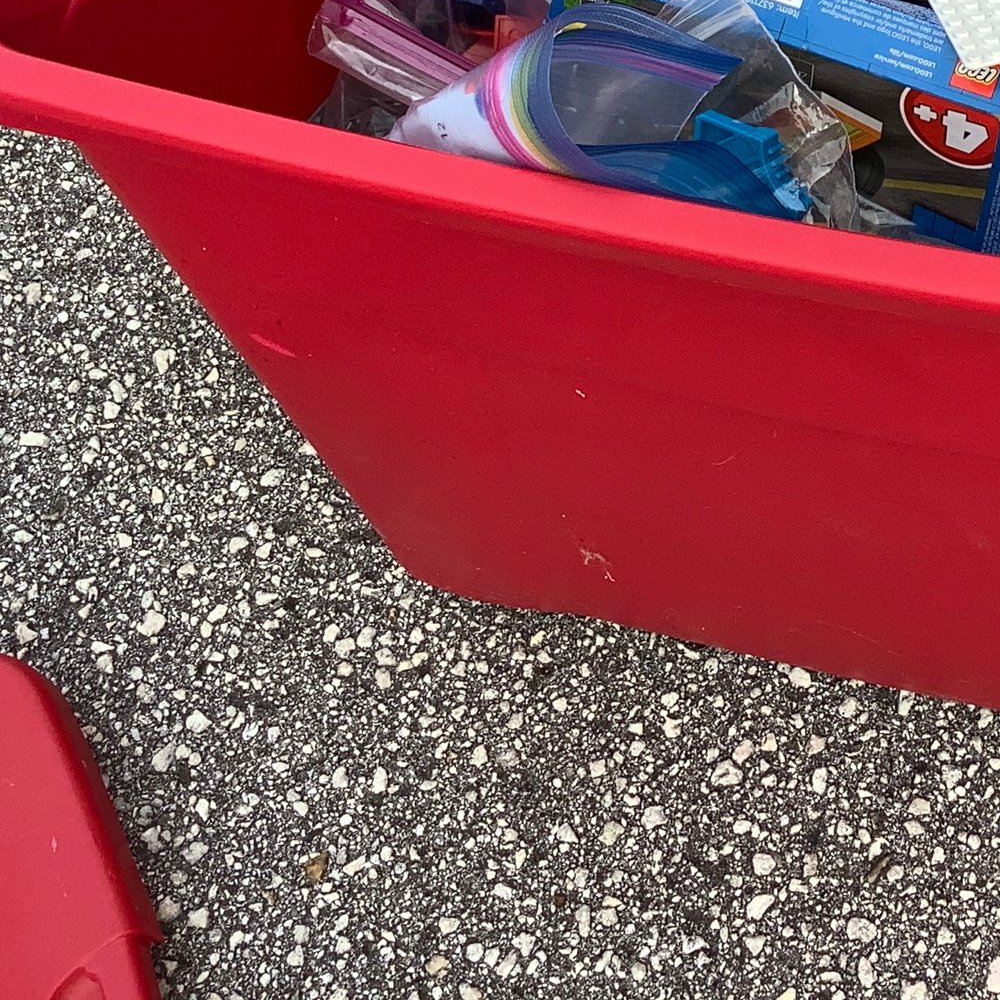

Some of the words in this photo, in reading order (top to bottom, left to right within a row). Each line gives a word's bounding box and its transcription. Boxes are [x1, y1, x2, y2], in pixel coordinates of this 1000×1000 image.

[775, 3, 800, 18] Item:
[850, 16, 863, 26] the
[875, 24, 891, 35] logo
[890, 29, 910, 41] LEGO
[874, 53, 933, 78] LEGO.com/service
[888, 47, 937, 68] LEGO.com/life
[437, 121, 448, 139] 12
[914, 104, 989, 154] 4+
